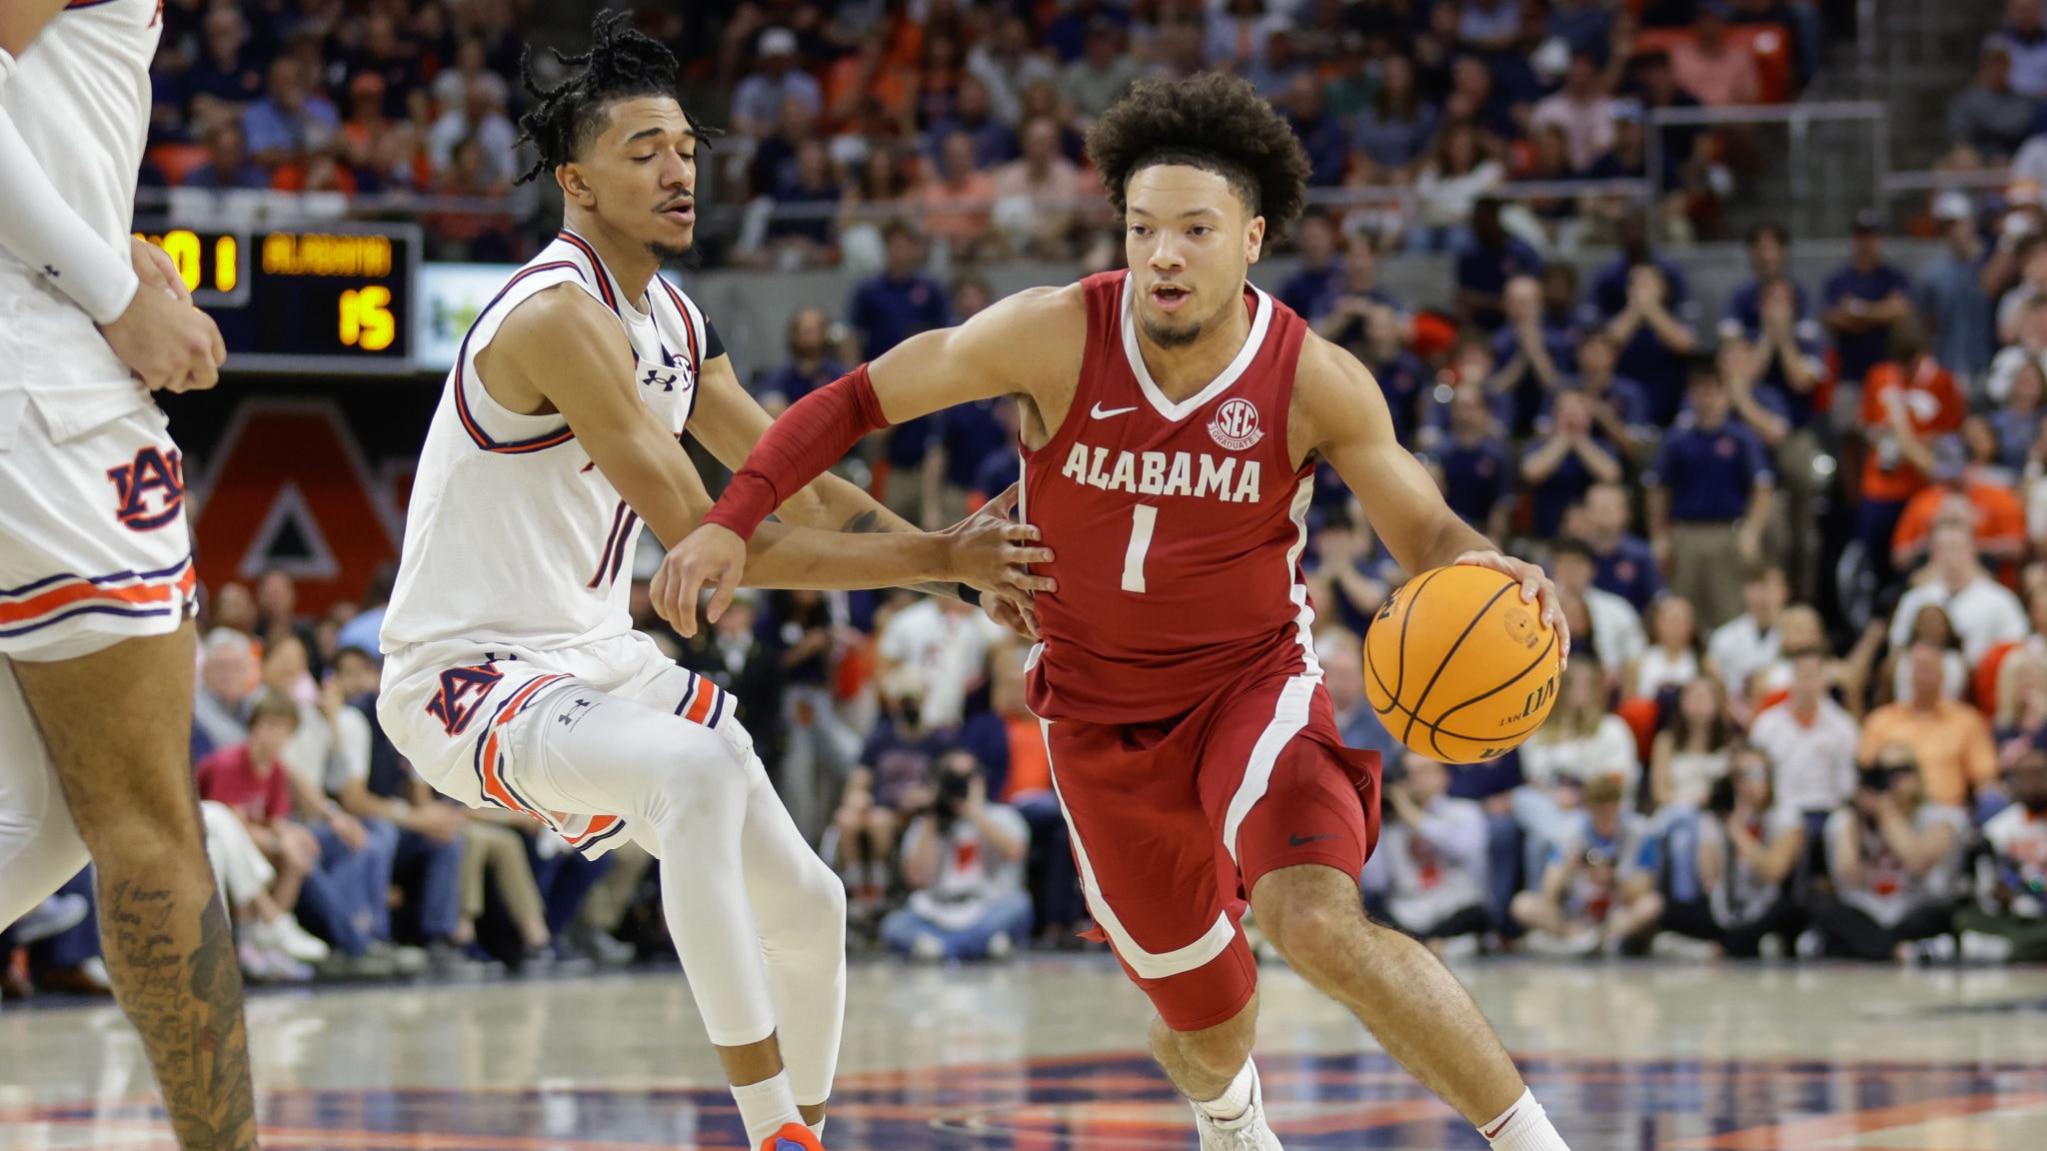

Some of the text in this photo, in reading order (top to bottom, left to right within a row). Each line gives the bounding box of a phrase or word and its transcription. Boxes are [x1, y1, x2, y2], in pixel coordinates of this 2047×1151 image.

[339, 285, 395, 350] 15
[1211, 428, 1256, 450] GRADUATE
[1219, 400, 1256, 438] SEC
[1062, 441, 1261, 503] ALABAMA
[1120, 503, 1159, 593] 1
